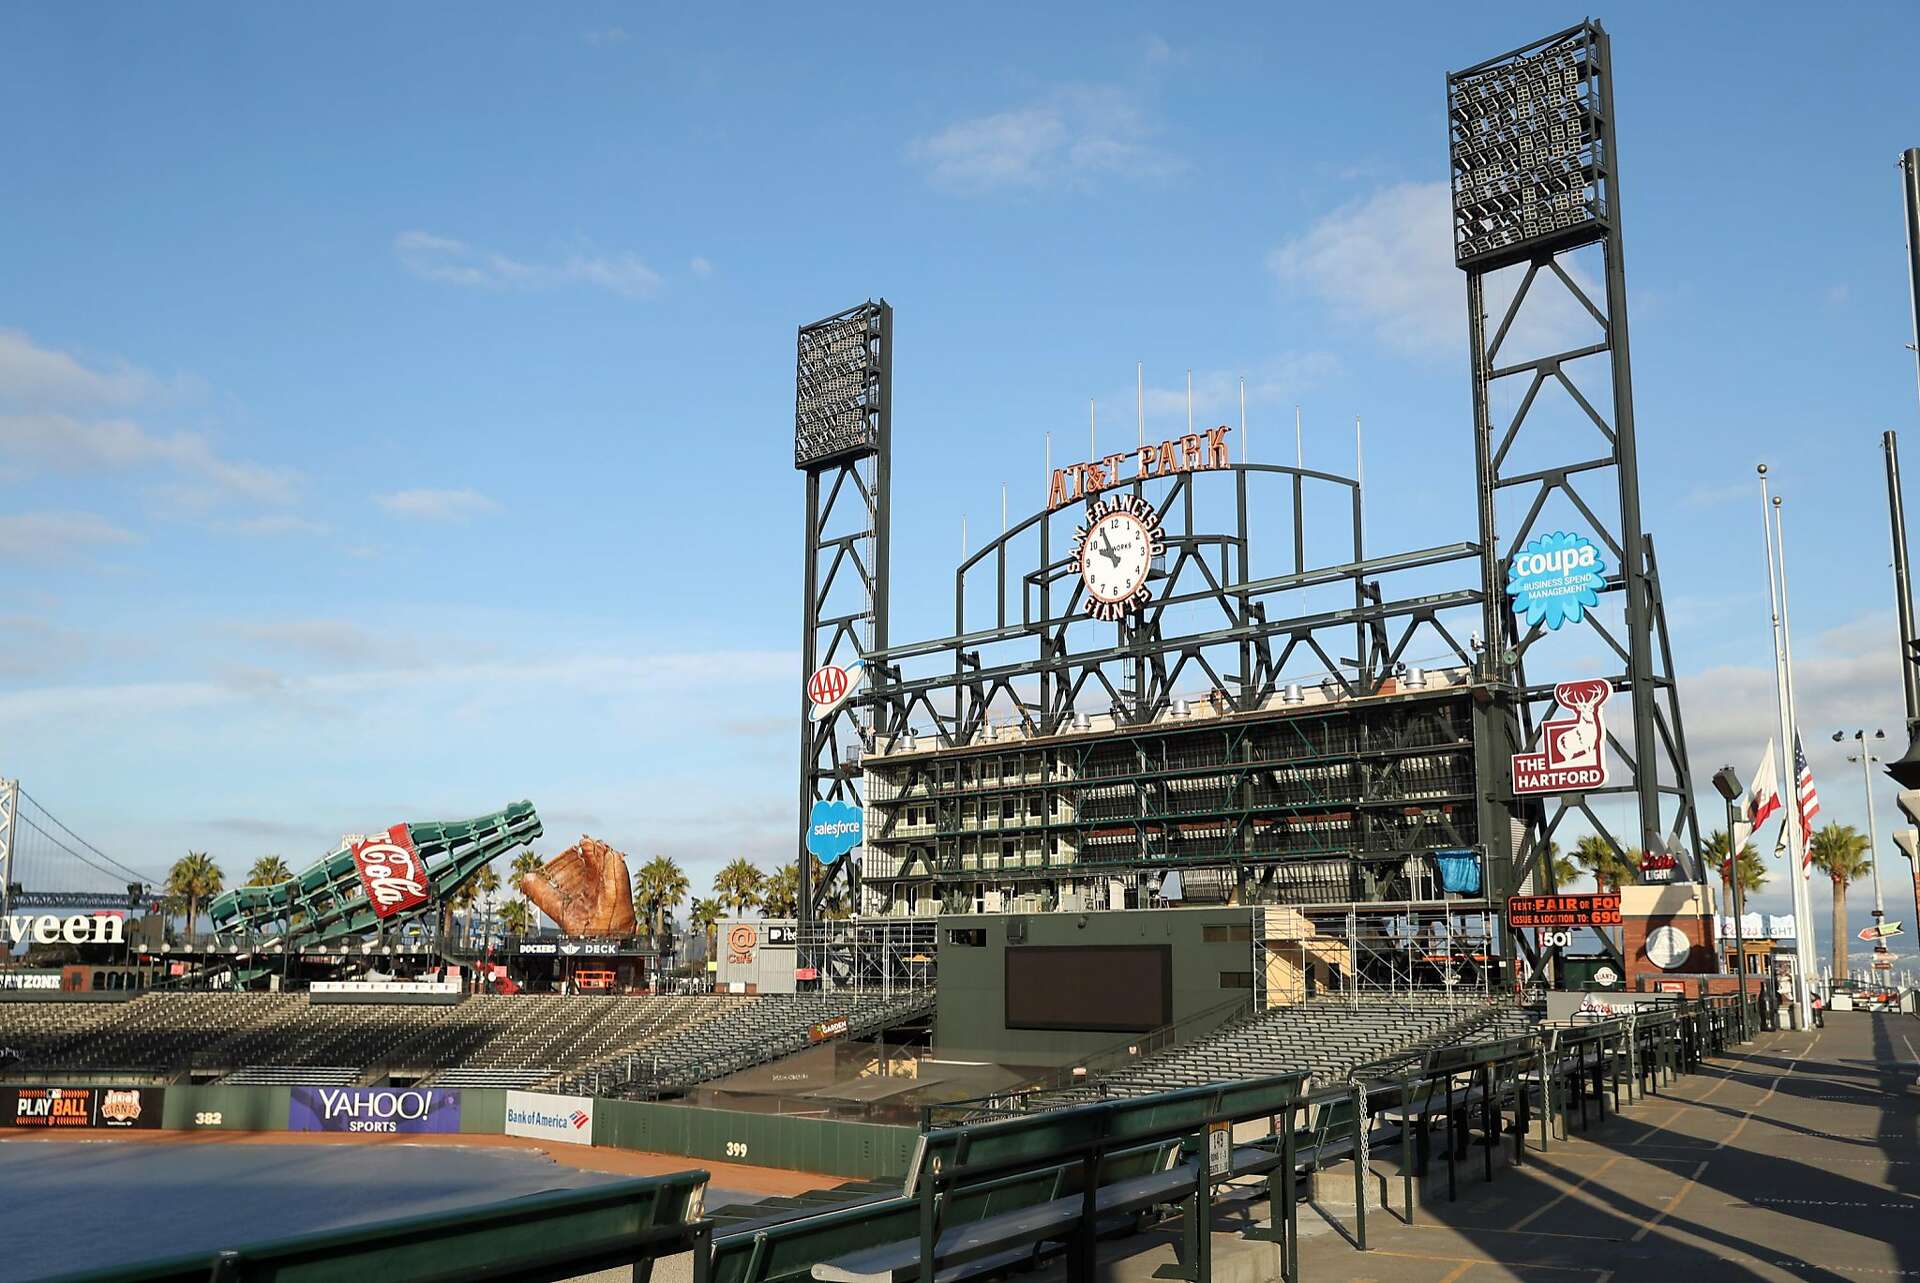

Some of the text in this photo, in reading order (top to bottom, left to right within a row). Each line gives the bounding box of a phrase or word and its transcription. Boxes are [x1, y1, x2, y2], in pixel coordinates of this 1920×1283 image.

[1048, 425, 1232, 510] AT&T PARK
[1111, 519, 1119, 530] 12
[1067, 493, 1167, 573] SAN FRANCISCO
[1135, 530, 1140, 540] 2
[1090, 541, 1098, 551] 10
[1140, 547, 1145, 556] 3
[1086, 558, 1091, 568] 9
[1516, 545, 1596, 576] coupa
[1135, 565, 1140, 575] 4
[1090, 574, 1095, 584] 8
[1126, 579, 1131, 589] 5
[1523, 573, 1592, 591] BUSINESS SPEND
[1100, 584, 1105, 593] 7
[1113, 586, 1118, 596] 6
[1528, 585, 1586, 600] MANAGEMENT
[1083, 584, 1153, 621] GIANTS
[811, 667, 843, 704] AAA
[1517, 758, 1546, 772] THE
[1518, 769, 1600, 788] HARTFORD
[814, 820, 859, 838] salesforce
[1645, 868, 1671, 881] LIGHT
[1512, 902, 1536, 911] TEXT:
[1536, 898, 1578, 910] FAIR
[1579, 901, 1590, 909] OR
[1513, 915, 1532, 924] ISSUE
[1577, 914, 1589, 923] TO:
[729, 924, 757, 954] @
[520, 944, 616, 954] DOCKERS DECK
[23, 974, 61, 989] ZONE
[1612, 1003, 1638, 1015] LIGH
[17, 1098, 88, 1116] PLAY BALL
[104, 1102, 139, 1116] GIANTS
[319, 1089, 433, 1120] YAHOO!
[195, 1112, 222, 1125] 382
[508, 1109, 567, 1129] Bank of America
[349, 1121, 397, 1133] SPORTS
[726, 1142, 747, 1158] 399
